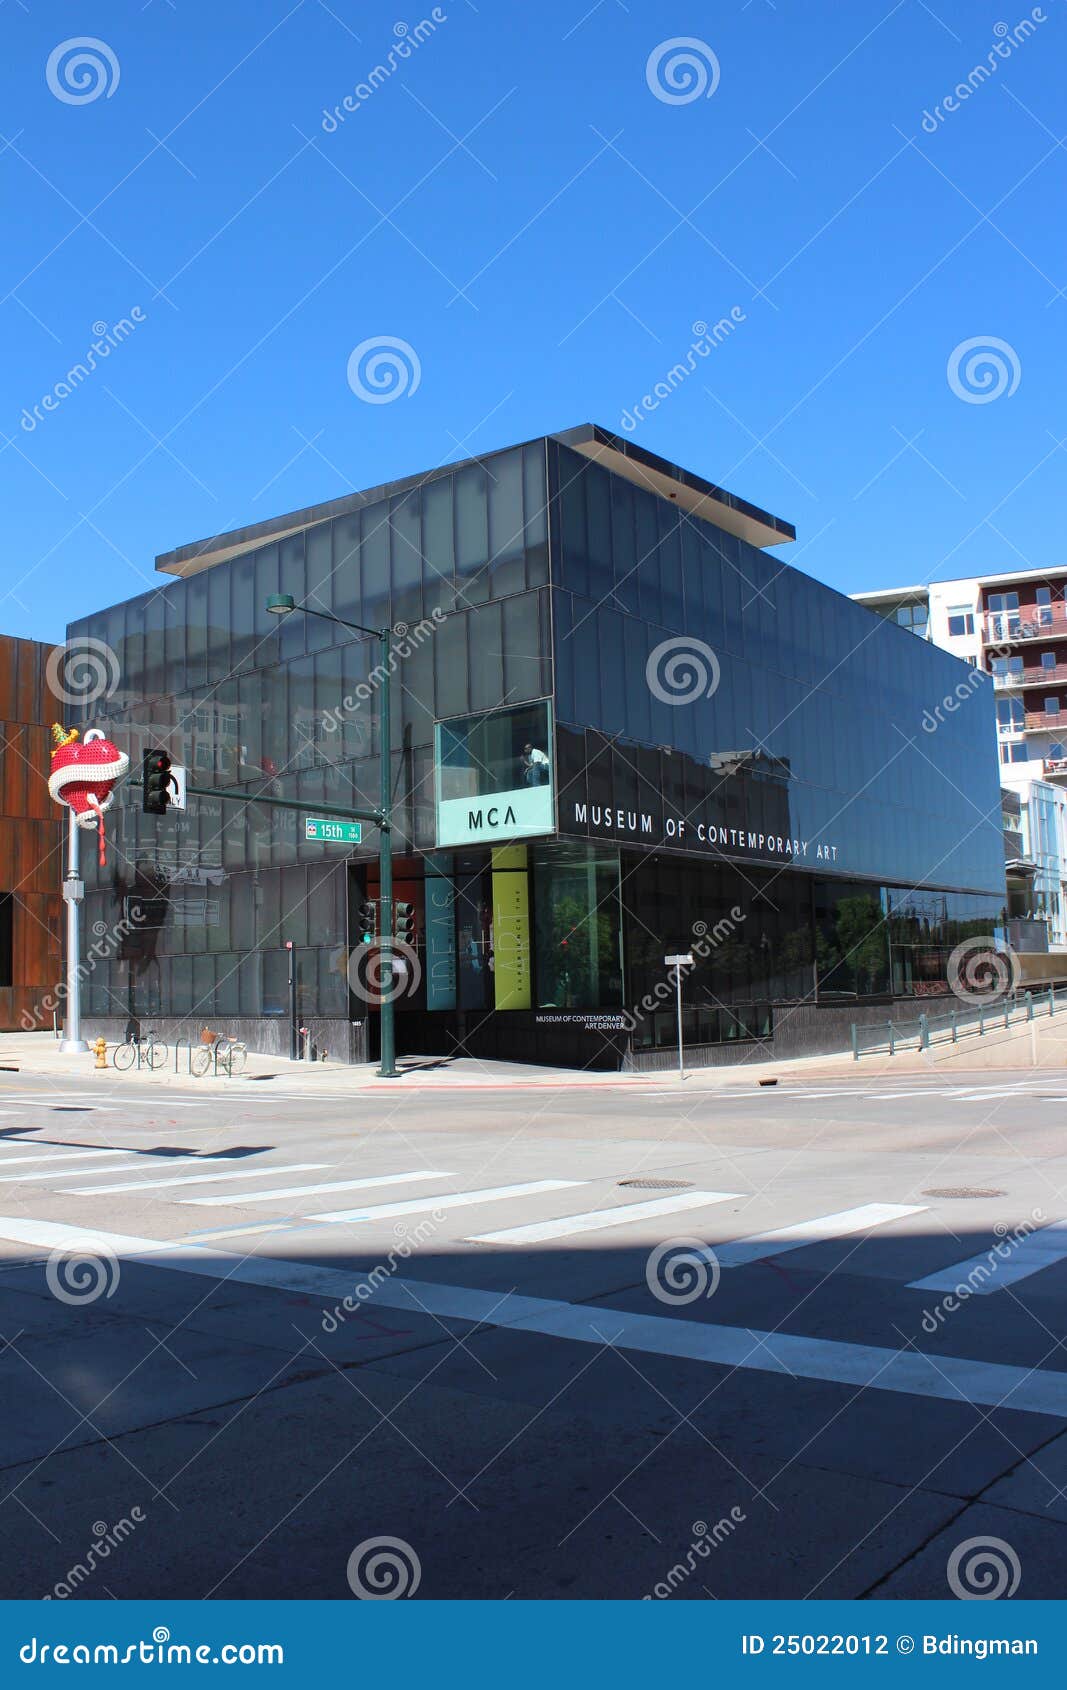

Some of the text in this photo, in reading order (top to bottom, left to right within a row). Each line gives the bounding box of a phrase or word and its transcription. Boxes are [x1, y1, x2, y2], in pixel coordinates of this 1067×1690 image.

[468, 805, 516, 830] MCA
[321, 824, 343, 838] 15th
[575, 803, 838, 861] MUSEUM OF CONTEMPORARY ART
[535, 1015, 624, 1023] MUSEUM OF CONTEMPORARY
[584, 1022, 625, 1030] ART DENVER
